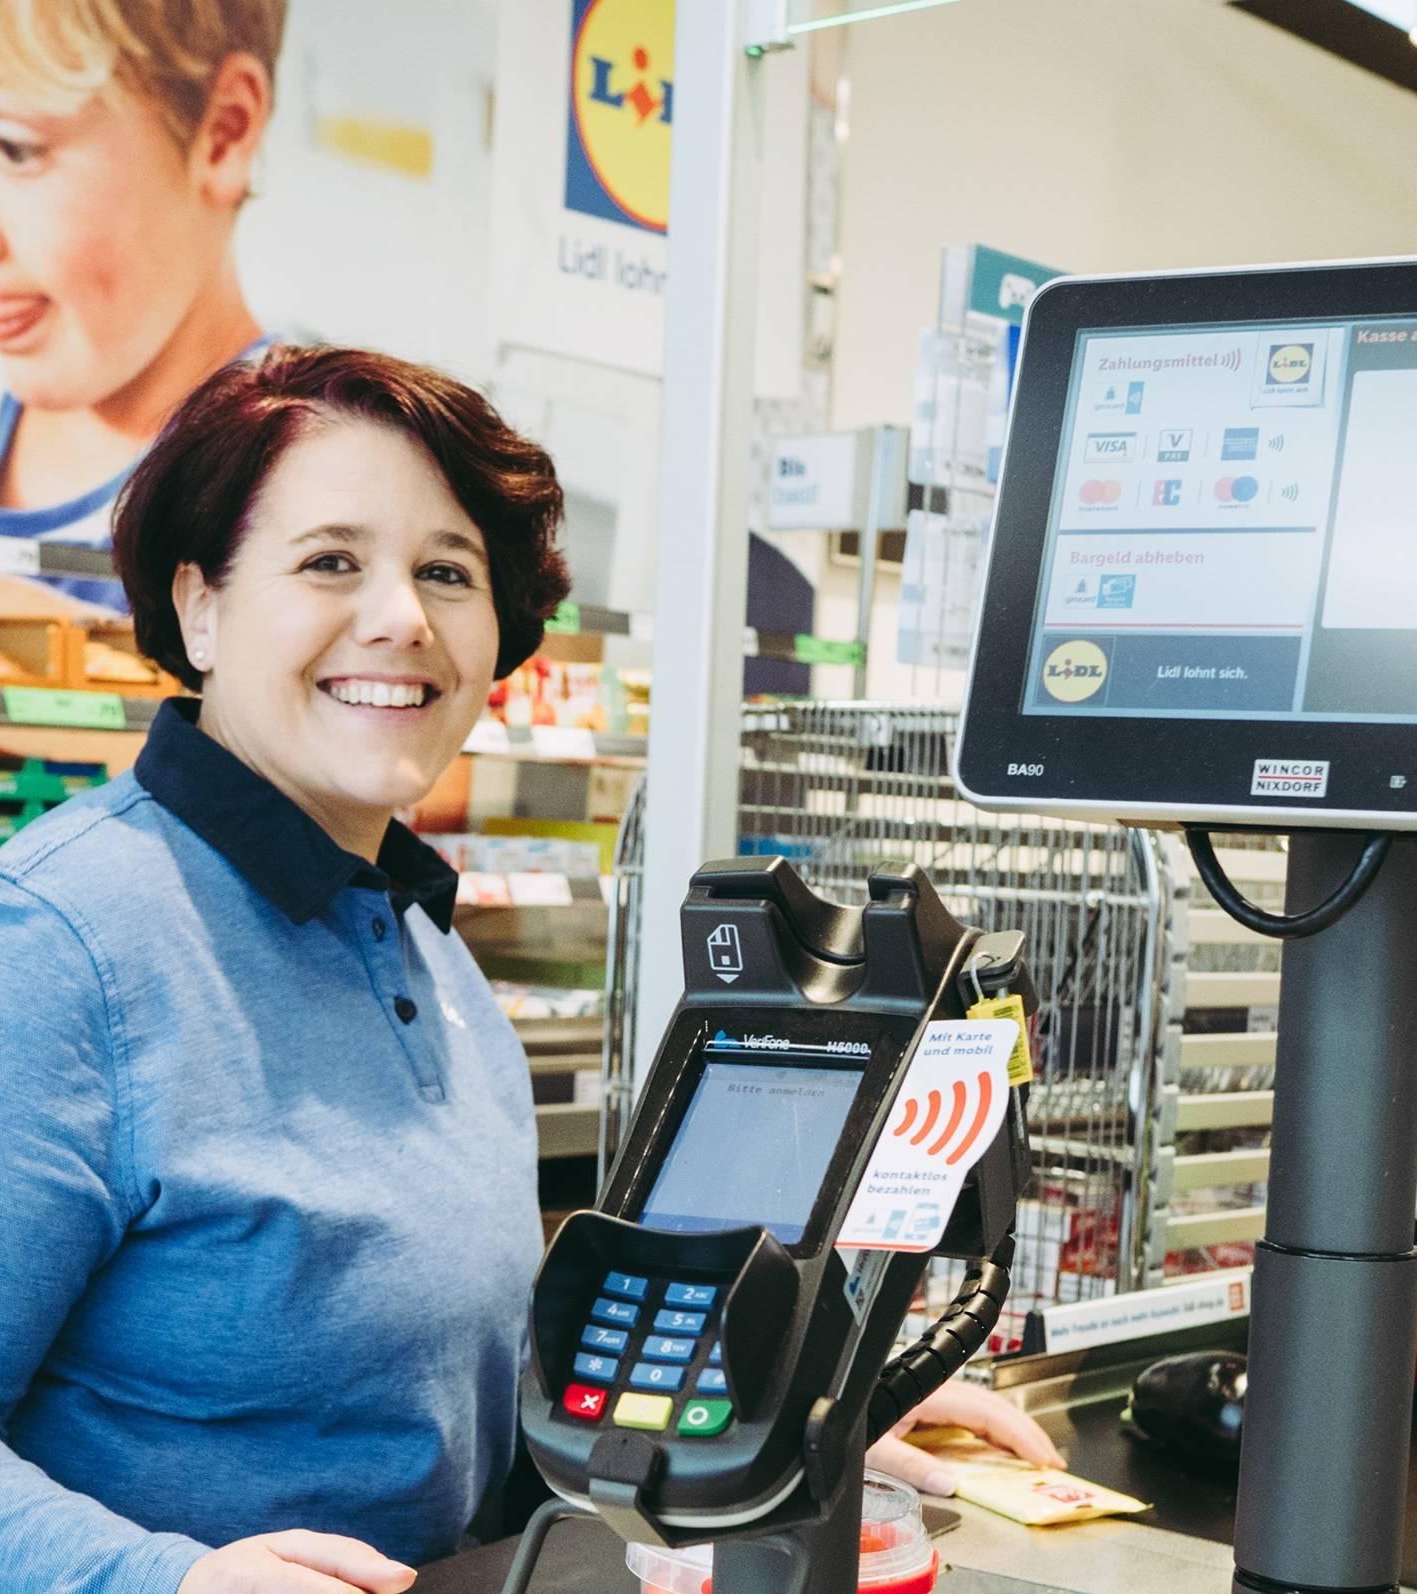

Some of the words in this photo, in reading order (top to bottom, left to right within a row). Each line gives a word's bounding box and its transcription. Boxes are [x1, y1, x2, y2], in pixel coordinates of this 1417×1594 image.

[588, 46, 673, 127] LI
[557, 236, 607, 281] Lidl
[615, 250, 668, 294] lohn
[1356, 330, 1408, 344] Kasse
[1098, 353, 1219, 372] Zahlungsmittel
[1095, 440, 1127, 454] VISA
[1168, 433, 1184, 448] V
[1070, 551, 1131, 567] Bargeld
[1135, 550, 1204, 564] abheben
[1157, 665, 1181, 679] Lidl
[1184, 665, 1215, 679] lohnt
[1219, 666, 1249, 680] sich.
[1007, 763, 1044, 777] BA90
[1258, 763, 1324, 776] WINCOR
[1255, 780, 1322, 793] NIXDORF
[743, 1034, 790, 1050] VeriFone
[929, 1033, 952, 1042] Mit
[956, 1032, 992, 1041] Karte
[826, 1041, 868, 1054] H5000
[923, 1047, 951, 1056] und
[953, 1045, 993, 1055] mobil
[727, 1083, 762, 1095] Bitte
[873, 1171, 948, 1181] kontaktlos
[867, 1184, 931, 1195] bezahlen
[622, 1278, 631, 1290] 1
[683, 1288, 695, 1300] 2
[607, 1303, 617, 1316] 4
[672, 1313, 685, 1326] 5
[596, 1331, 607, 1343] 7
[660, 1340, 672, 1353] 8
[649, 1368, 663, 1382] 0
